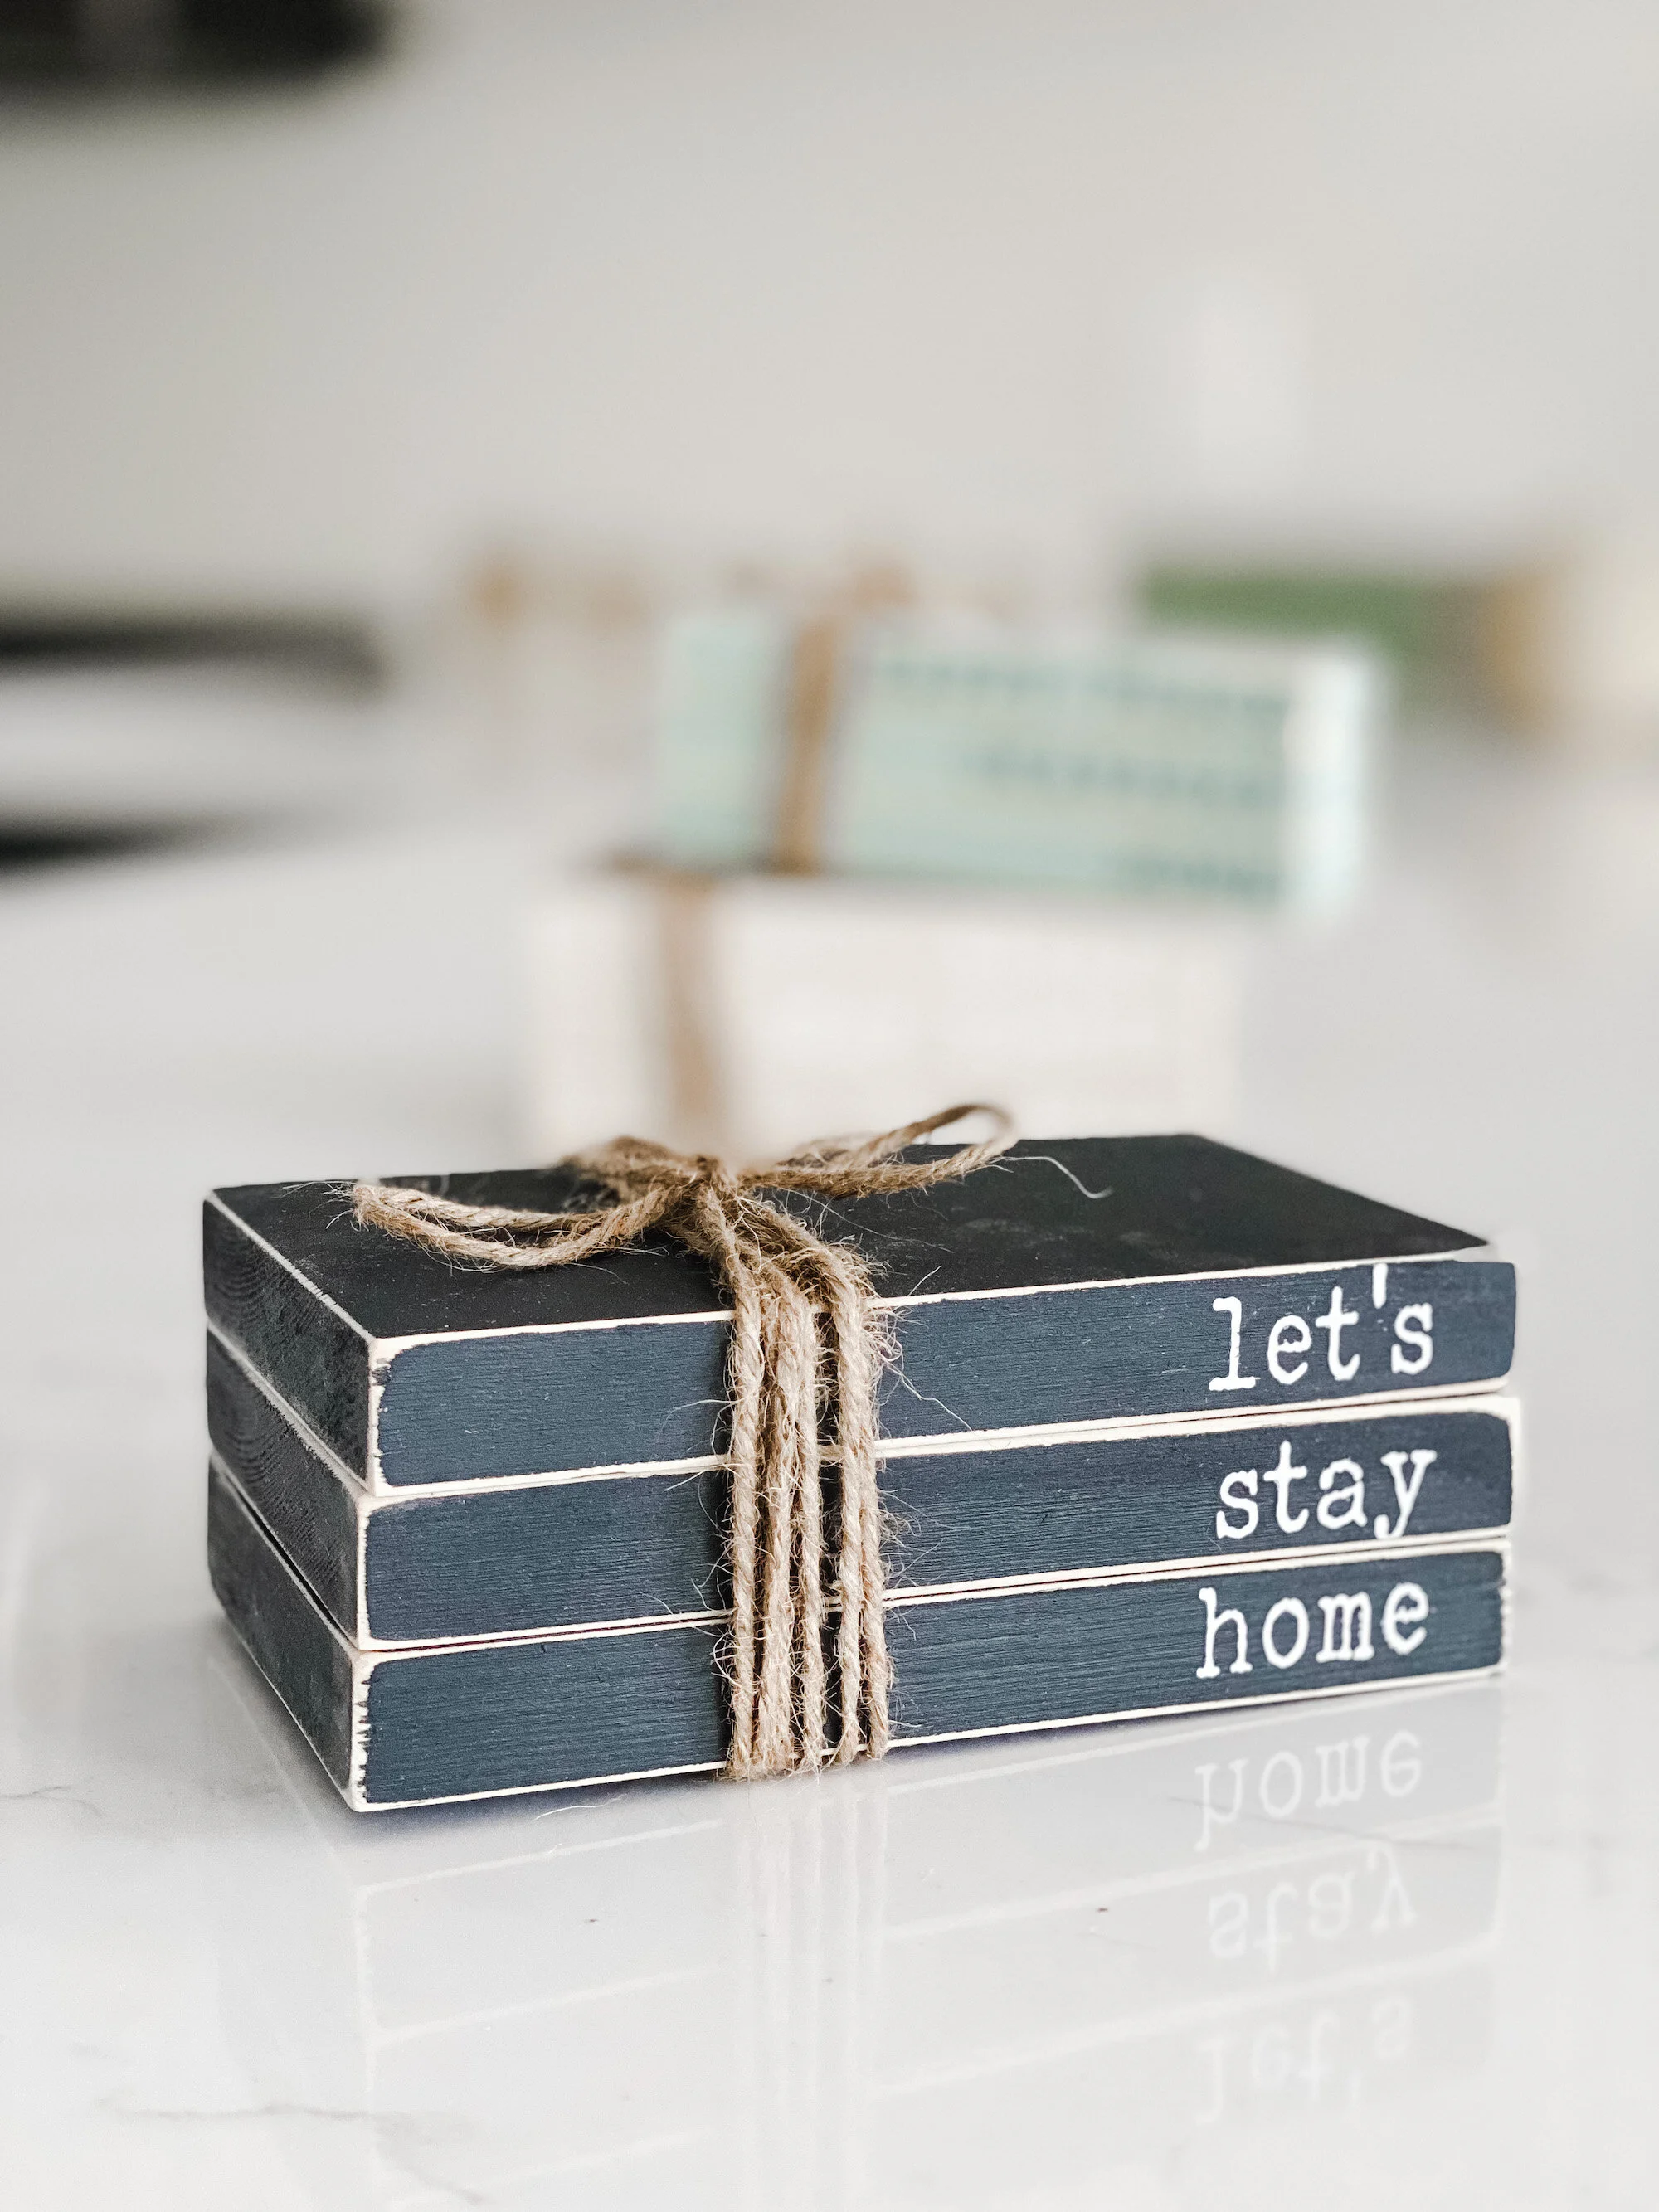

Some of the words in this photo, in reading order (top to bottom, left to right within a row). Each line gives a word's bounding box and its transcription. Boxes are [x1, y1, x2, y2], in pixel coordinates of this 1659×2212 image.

[1209, 1262, 1434, 1391] let's
[1215, 1440, 1438, 1540] stay
[1196, 1582, 1430, 1679] home
